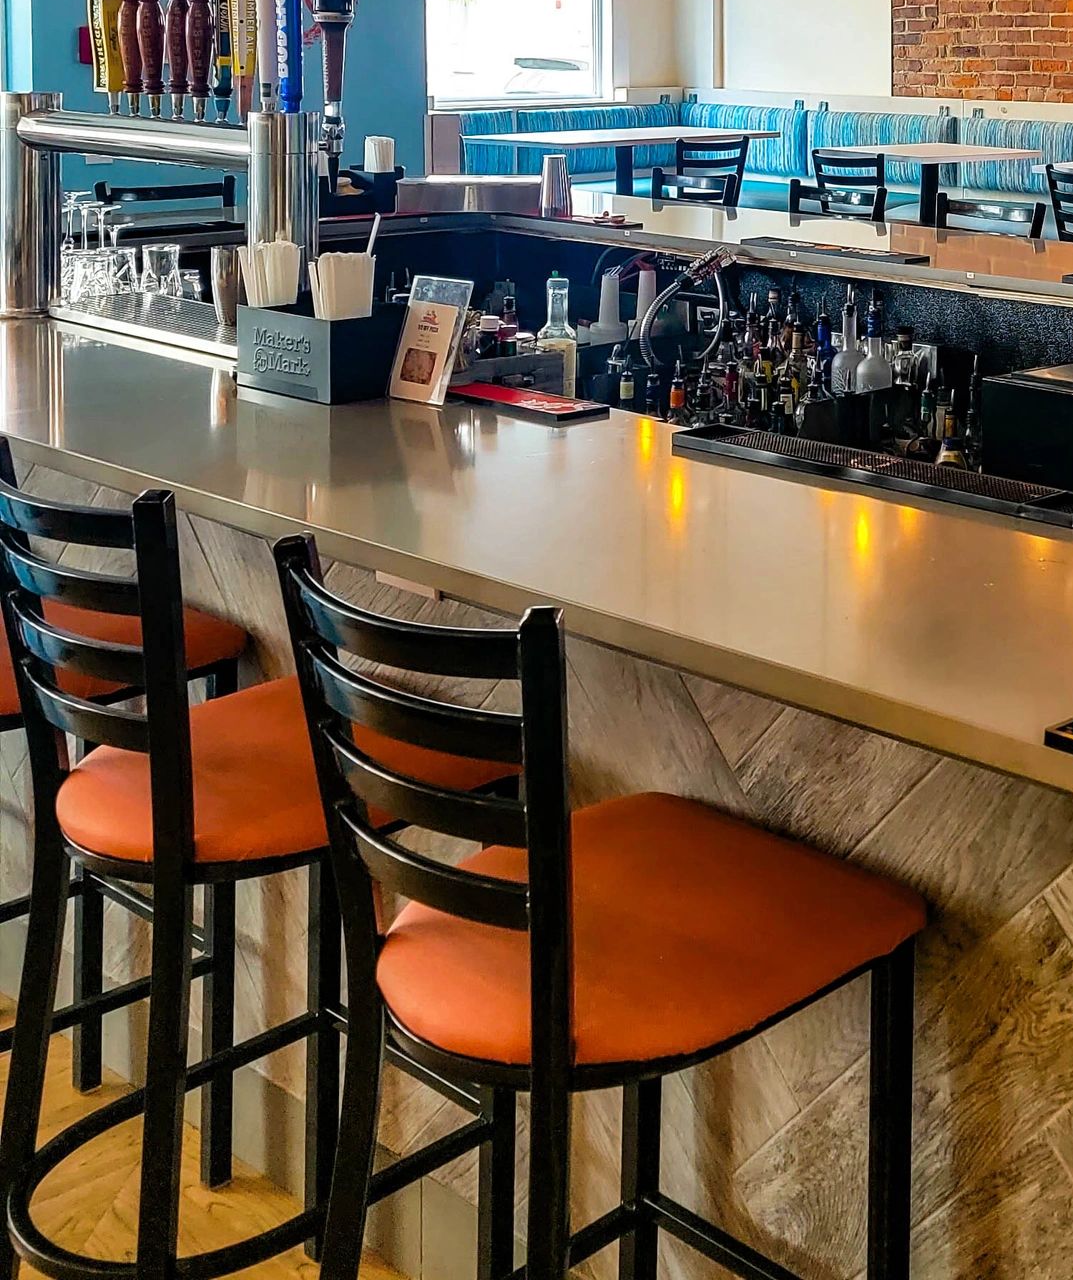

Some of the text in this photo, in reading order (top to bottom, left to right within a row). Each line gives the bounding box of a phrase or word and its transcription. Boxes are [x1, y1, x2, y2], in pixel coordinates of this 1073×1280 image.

[276, 32, 289, 78] BUD
[253, 327, 311, 354] Maker's
[268, 351, 311, 376] Mark
